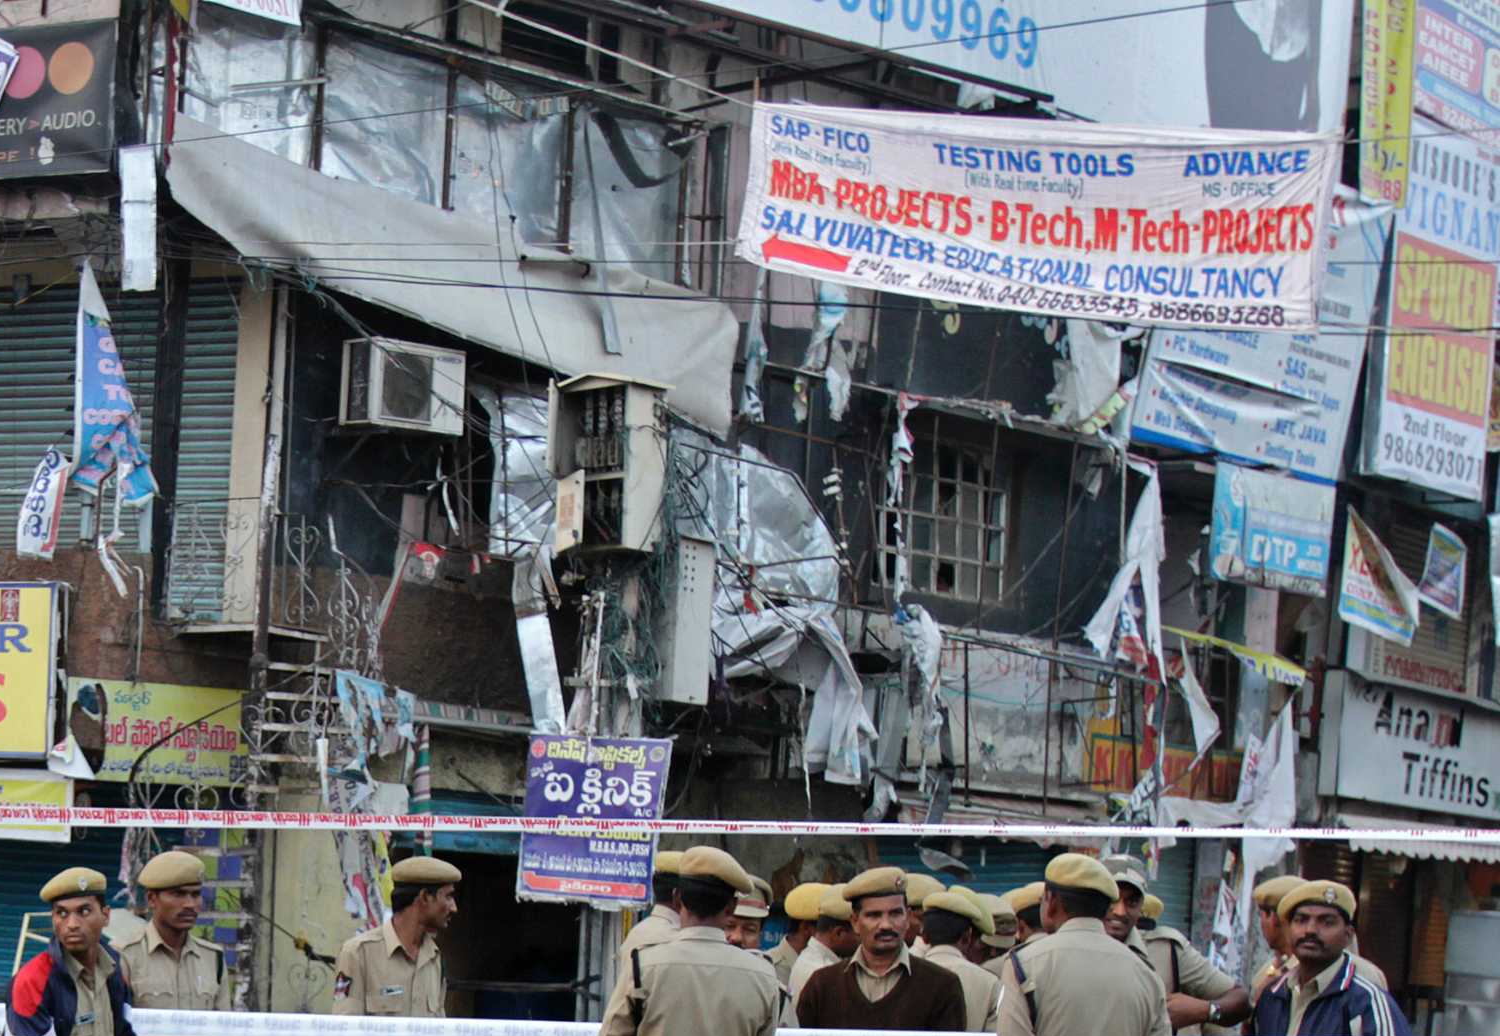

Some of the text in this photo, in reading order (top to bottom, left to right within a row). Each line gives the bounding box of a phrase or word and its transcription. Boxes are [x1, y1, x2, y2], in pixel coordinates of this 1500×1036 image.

[934, 143, 1311, 178] TESTING TOOLS ADVANCE
[770, 159, 825, 205] MBA
[835, 178, 972, 236] PROJECTS
[994, 174, 1015, 189] Real
[762, 205, 1285, 299] SAI YUVATECH EDUCATIONAL CONSULTANCY
[919, 272, 972, 296] Contact
[1398, 242, 1492, 335] SPOKEN
[1284, 356, 1307, 379] SAS
[1389, 332, 1487, 417] ENGLISH
[1299, 421, 1326, 445] JAVA
[1403, 413, 1467, 447] 2nd Floor
[1403, 751, 1491, 808] Tiffins
